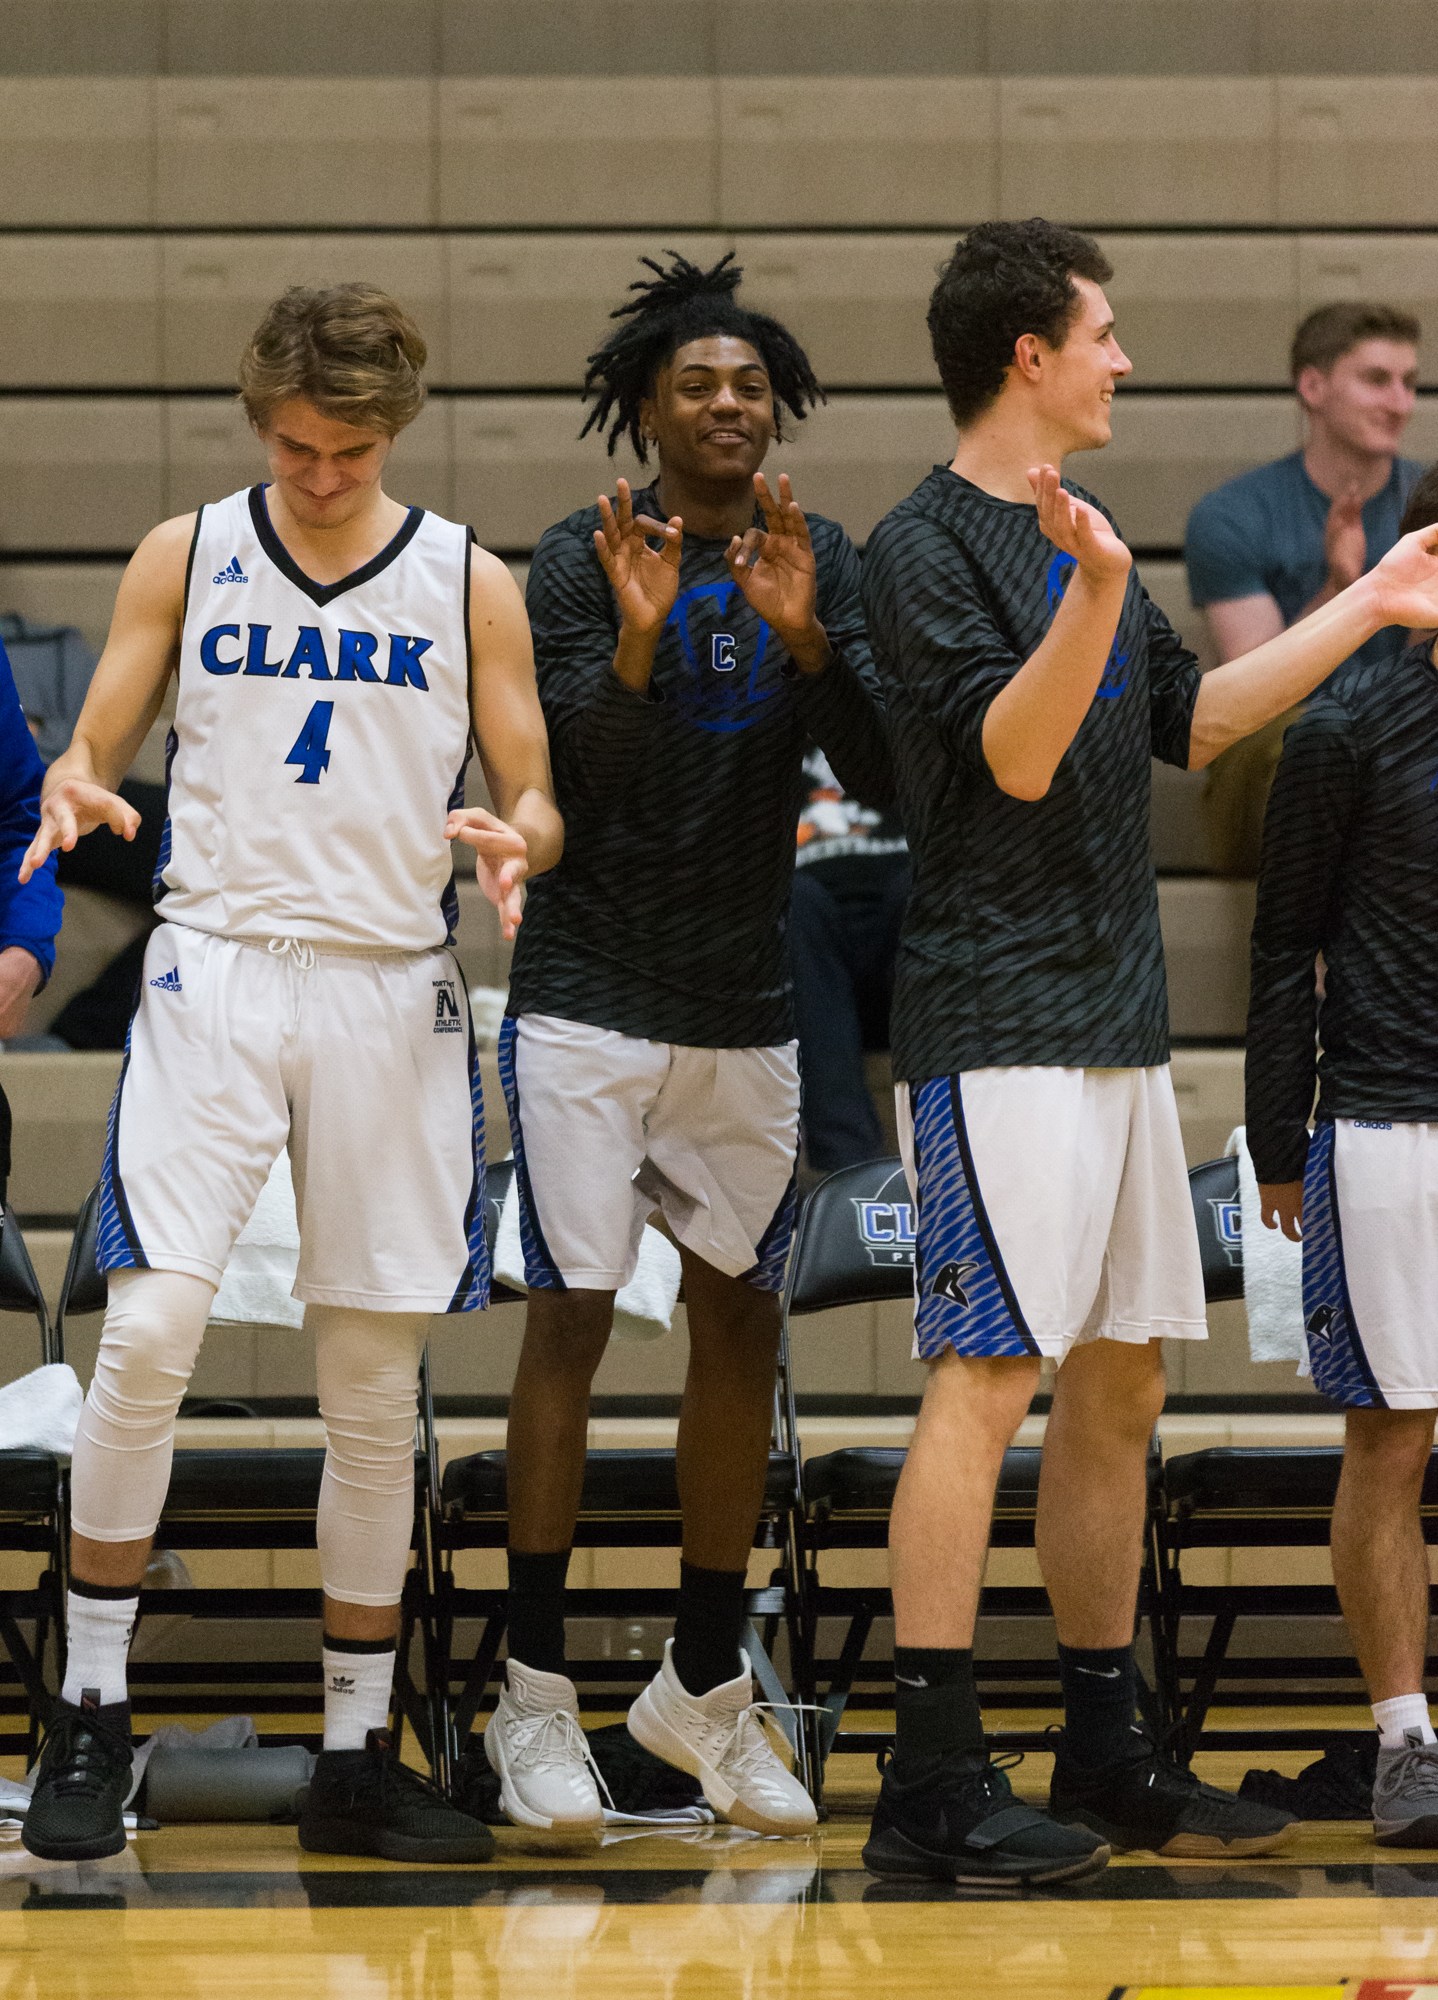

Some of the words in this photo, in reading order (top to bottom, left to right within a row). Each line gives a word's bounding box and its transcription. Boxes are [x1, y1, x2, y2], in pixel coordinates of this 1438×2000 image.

[200, 623, 434, 692] CLARK
[712, 634, 736, 671] C
[284, 700, 335, 784] 4
[1353, 1120, 1393, 1131] adidas
